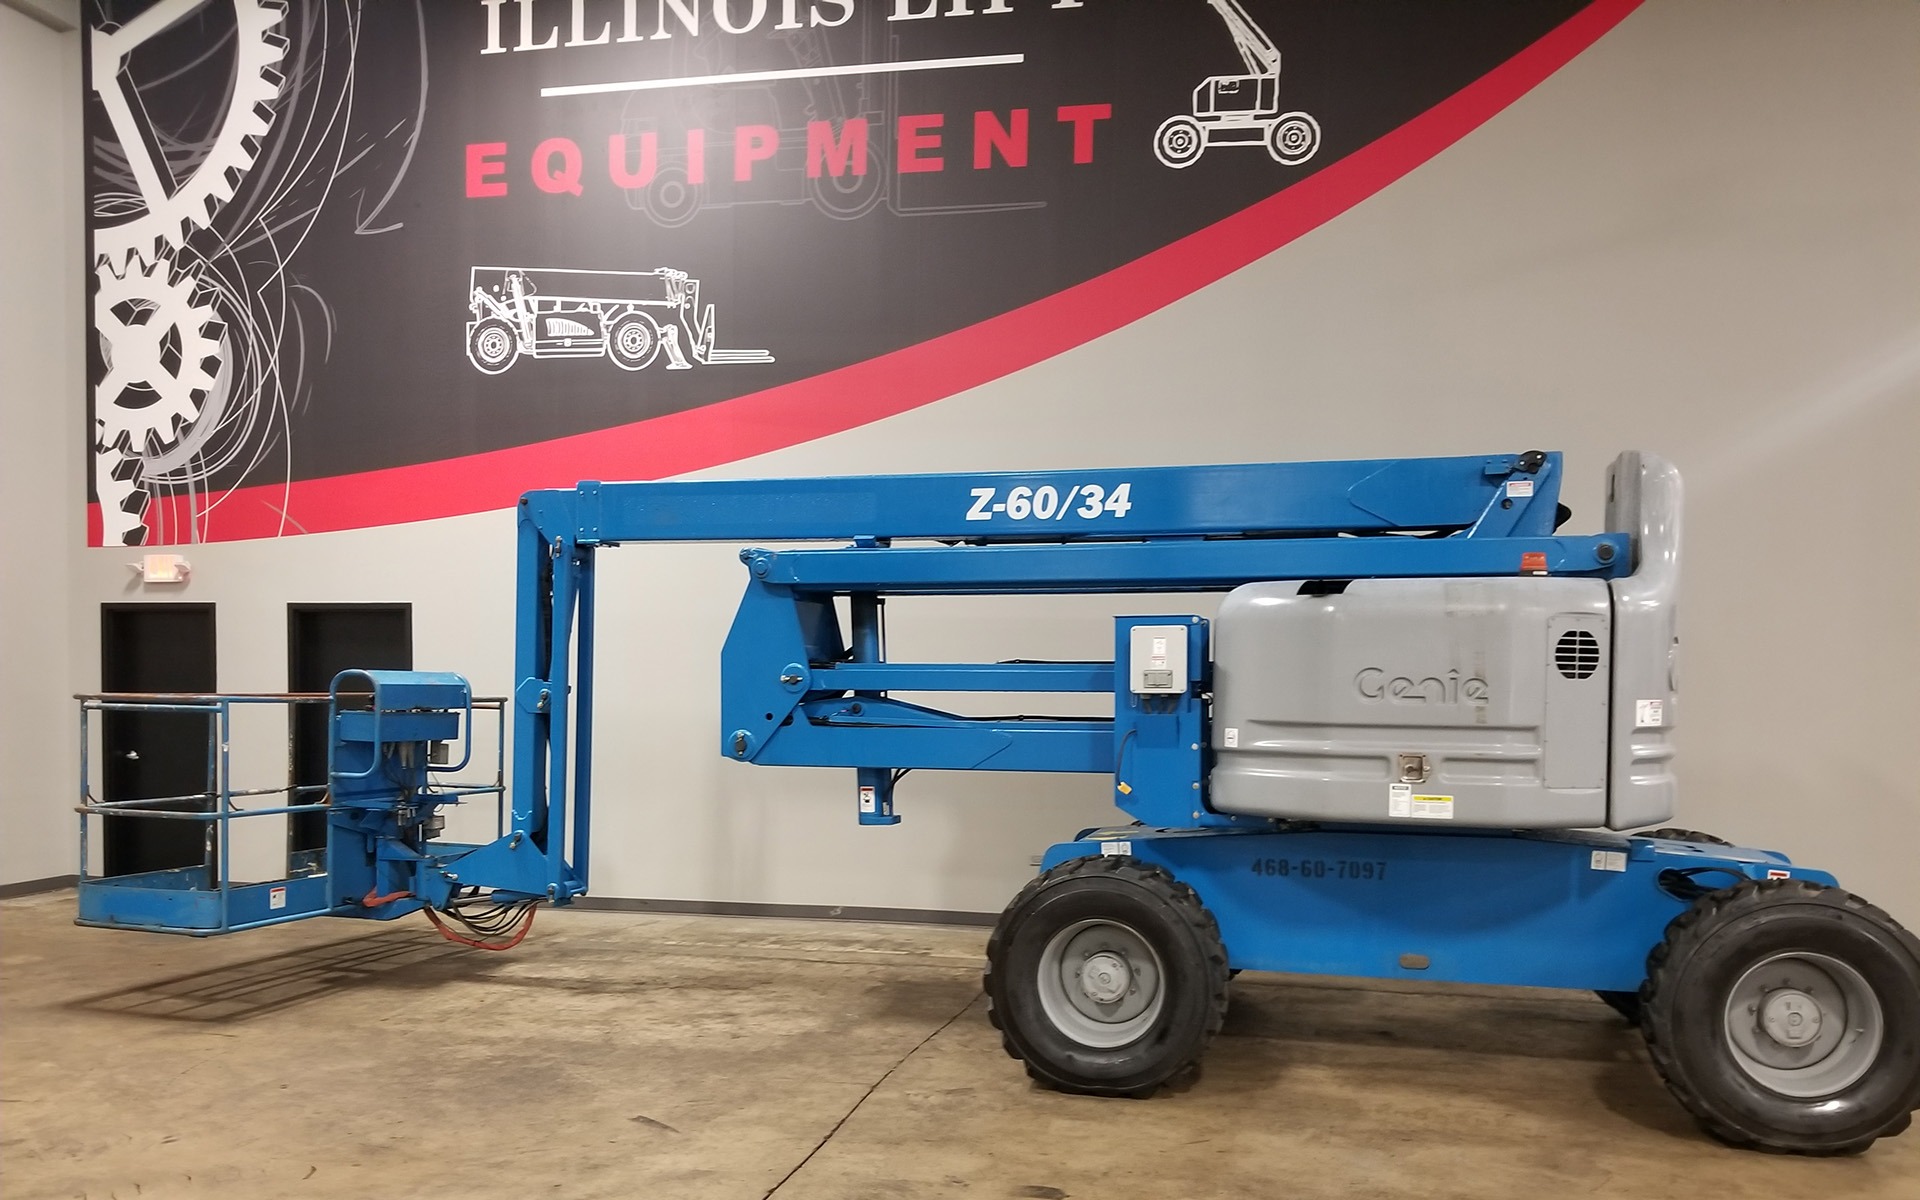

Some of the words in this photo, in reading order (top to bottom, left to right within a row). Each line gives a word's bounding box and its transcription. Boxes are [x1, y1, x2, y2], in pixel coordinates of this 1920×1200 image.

[480, 0, 855, 54] ILLINOIS
[465, 103, 1112, 198] EQUIPMENT
[965, 482, 1133, 521] Z-60/34
[1353, 667, 1489, 705] Genie
[1251, 858, 1387, 881] 468-60-7097
